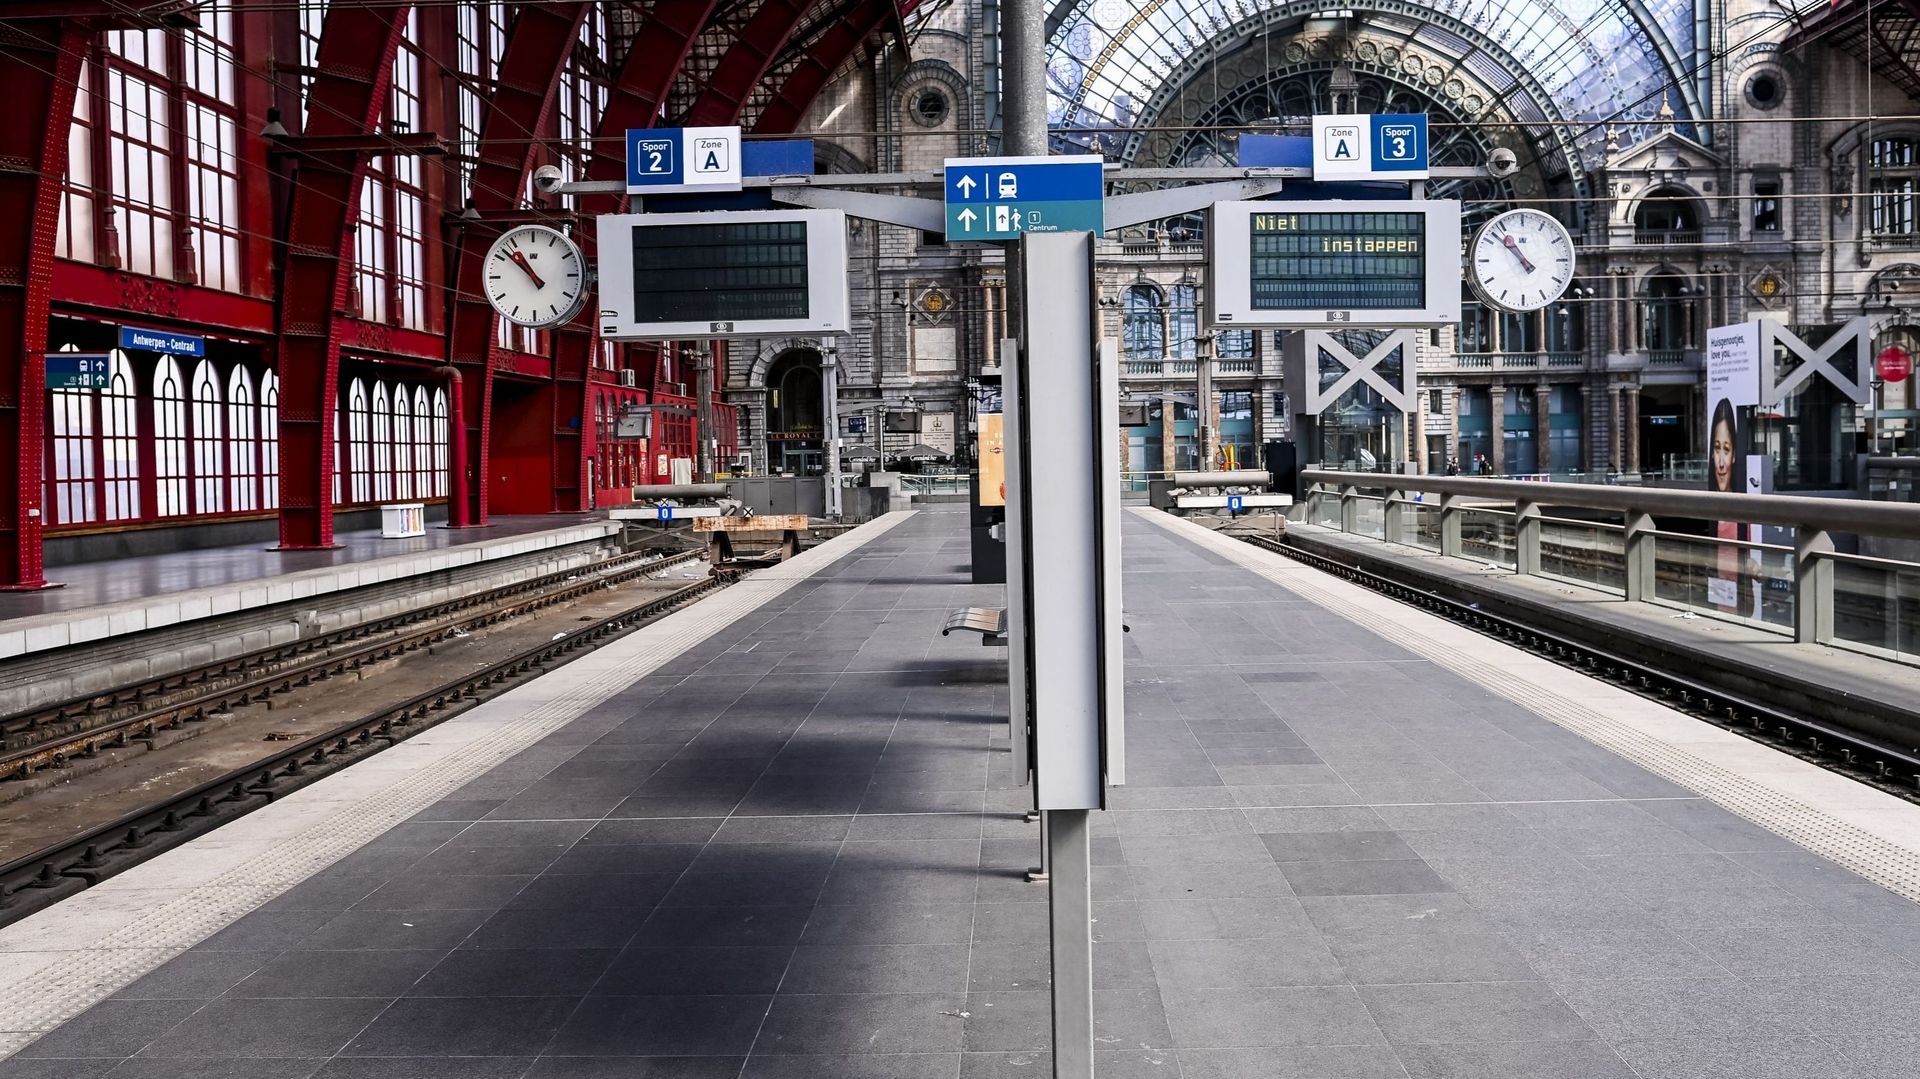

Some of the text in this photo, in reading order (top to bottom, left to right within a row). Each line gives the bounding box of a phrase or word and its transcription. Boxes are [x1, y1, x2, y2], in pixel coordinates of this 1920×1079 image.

[1331, 128, 1353, 136] Zone
[1386, 128, 1412, 138] Spoor
[642, 142, 668, 152] Spoor
[701, 140, 722, 148] Zone
[1334, 139, 1351, 158] A
[1392, 137, 1406, 158] 3
[649, 152, 662, 172] 2
[704, 150, 720, 170] A
[1256, 215, 1298, 230] Niet
[1323, 237, 1418, 252] instappen
[133, 333, 166, 350] Antwerpen
[170, 338, 196, 352] Centraal
[1232, 498, 1238, 509] 0
[662, 508, 668, 518] 0
